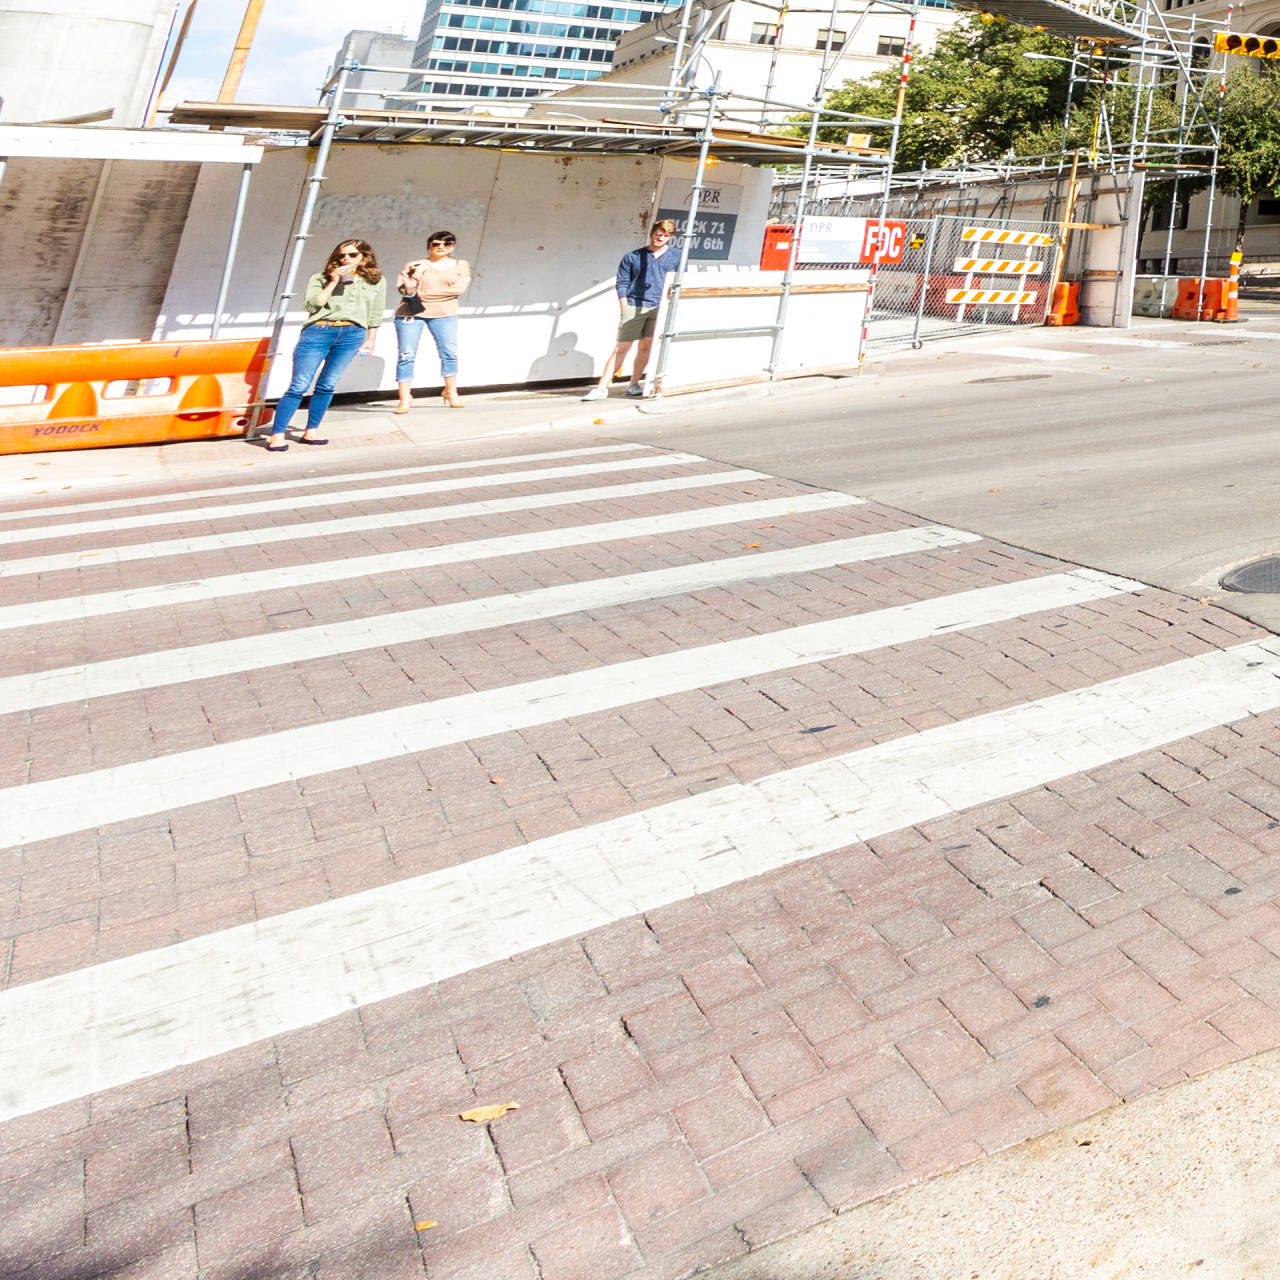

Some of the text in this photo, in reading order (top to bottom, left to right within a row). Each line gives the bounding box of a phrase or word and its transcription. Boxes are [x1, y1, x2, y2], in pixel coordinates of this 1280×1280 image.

[710, 222, 726, 234] 71
[810, 222, 833, 233] DPR
[688, 237, 701, 249] W
[703, 238, 724, 251] 6th
[864, 226, 902, 258] FDC
[33, 422, 103, 436] YODOCK
